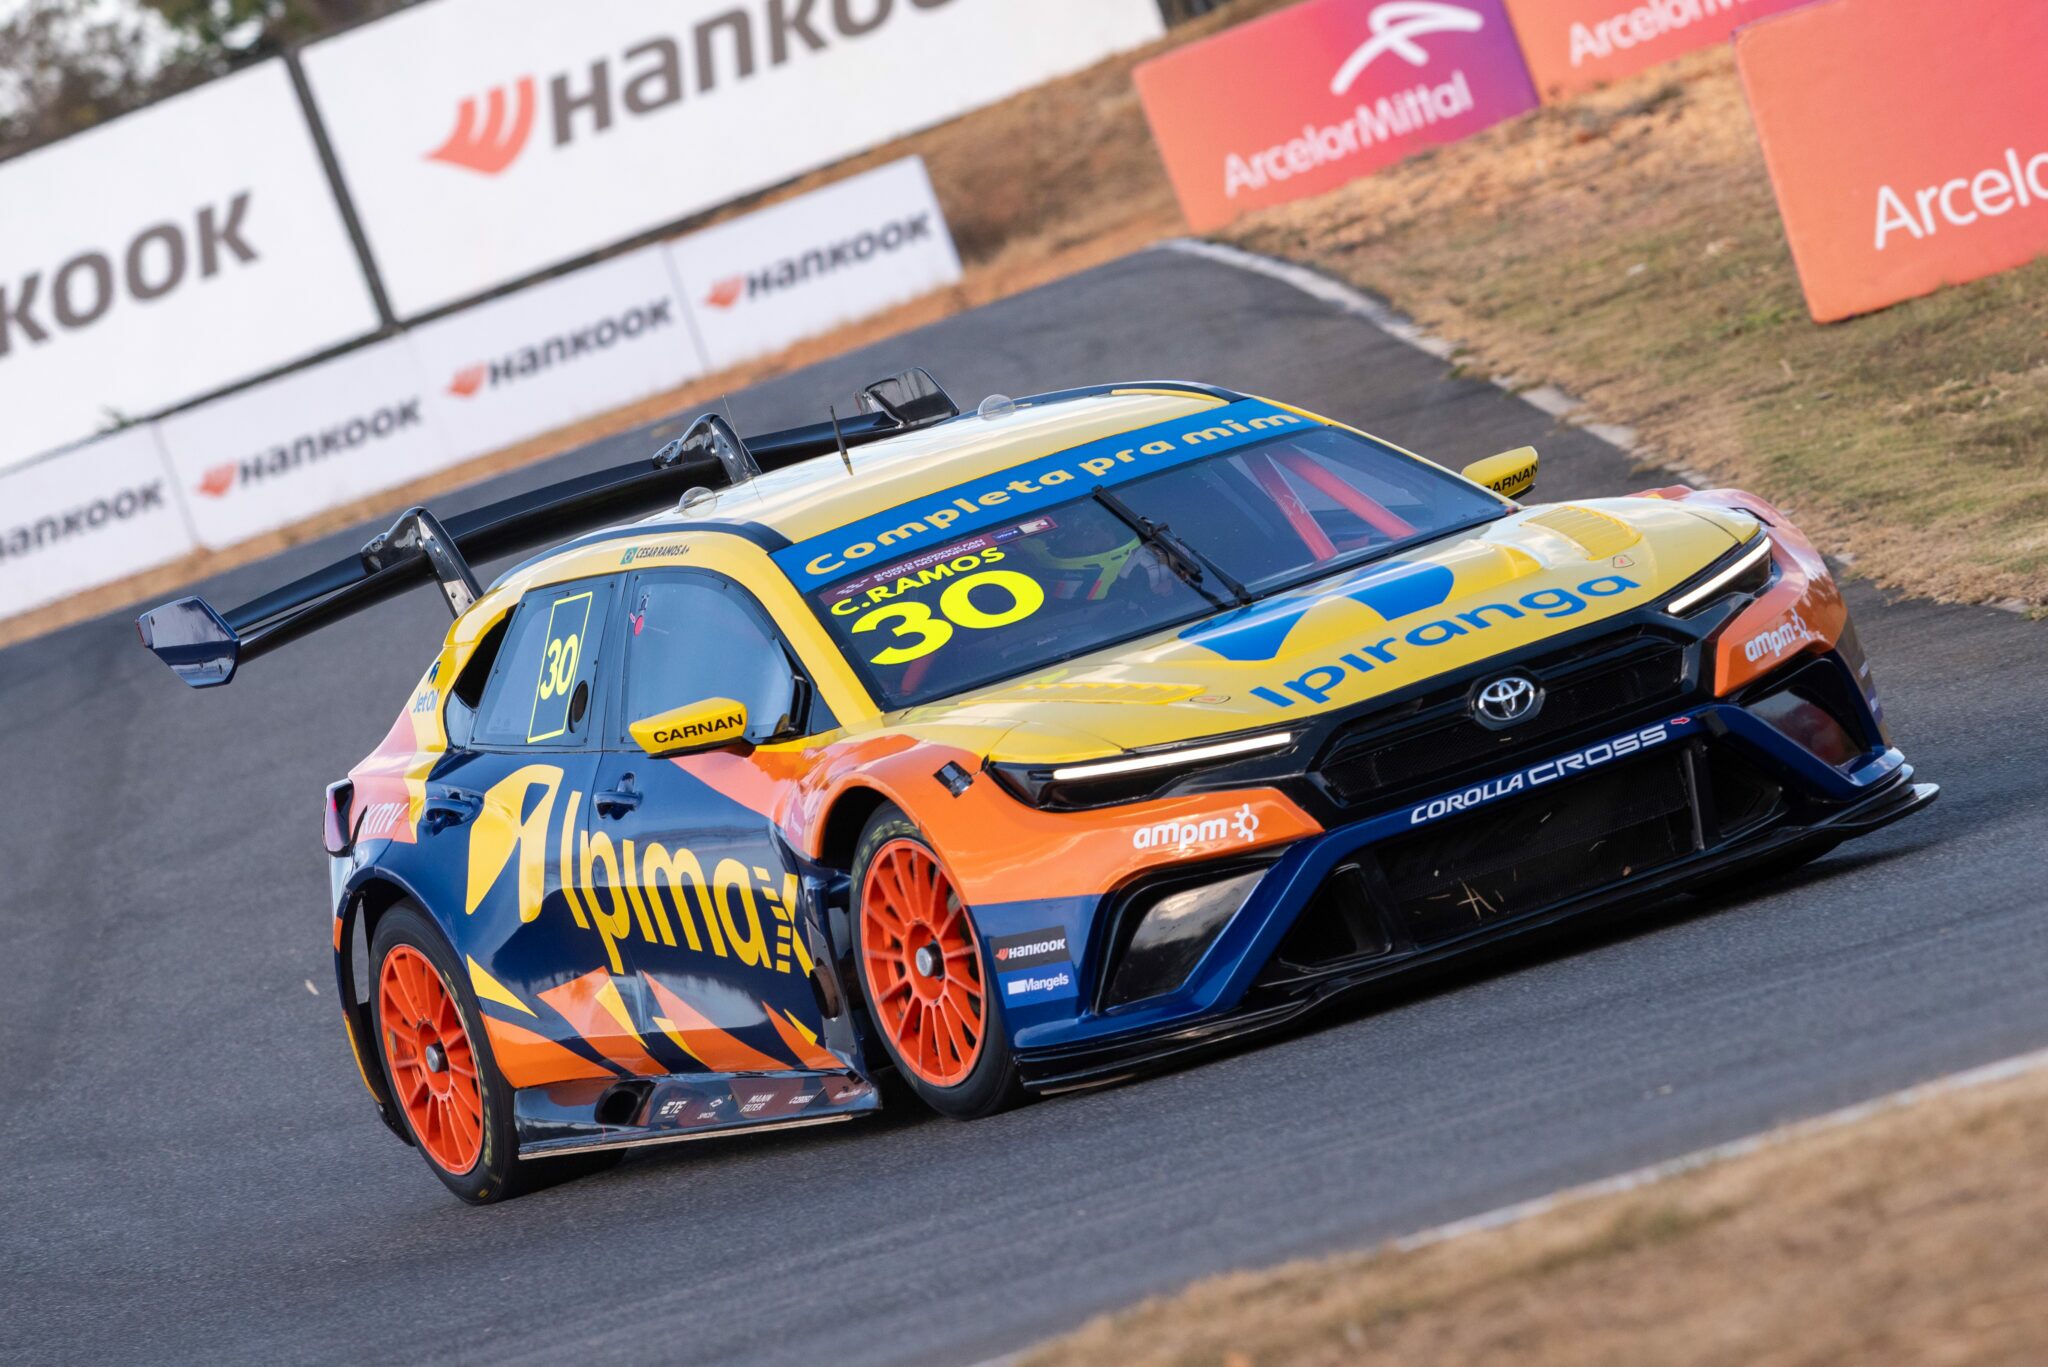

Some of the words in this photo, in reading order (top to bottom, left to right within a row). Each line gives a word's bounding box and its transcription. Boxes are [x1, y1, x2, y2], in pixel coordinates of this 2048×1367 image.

[549, 0, 955, 147] Hank
[1223, 69, 1474, 199] ArcelorMittal
[805, 470, 1074, 576] Completa
[1079, 440, 1174, 476] pra
[1182, 413, 1302, 445] mim
[1485, 460, 1538, 492] ARNAN
[831, 546, 1005, 616] C.RAMOS
[851, 570, 1045, 666] 30
[1249, 574, 1640, 708] Ipiranga
[1744, 622, 1797, 662] ampm
[540, 634, 579, 700] 30
[653, 713, 744, 744] CARNAN
[1410, 772, 1524, 825] COROLLA
[1527, 723, 1668, 786] CROSS
[1132, 817, 1228, 851] ampm
[1024, 972, 1070, 992] Mangels
